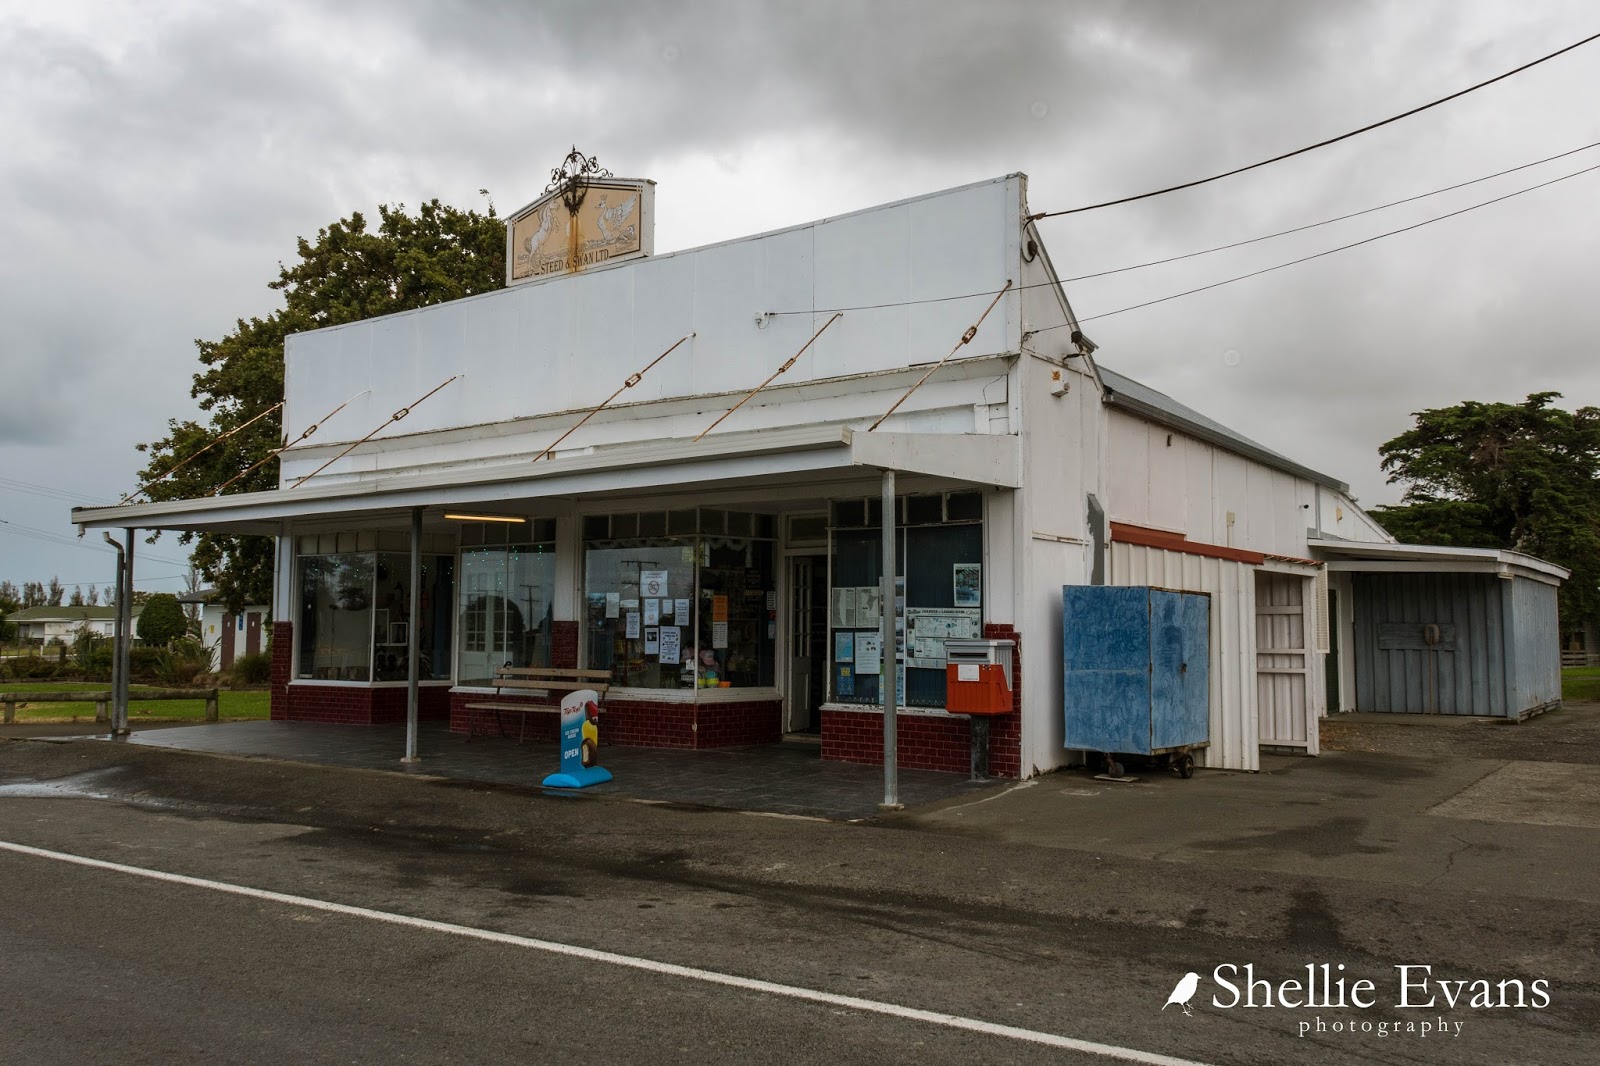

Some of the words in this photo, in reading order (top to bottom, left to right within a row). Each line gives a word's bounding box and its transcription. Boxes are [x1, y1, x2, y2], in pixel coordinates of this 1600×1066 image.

[540, 260, 563, 275] STEED
[565, 258, 571, 269] &
[573, 252, 594, 267] SWAN
[595, 249, 609, 263] LTD
[564, 748, 579, 760] OPEN
